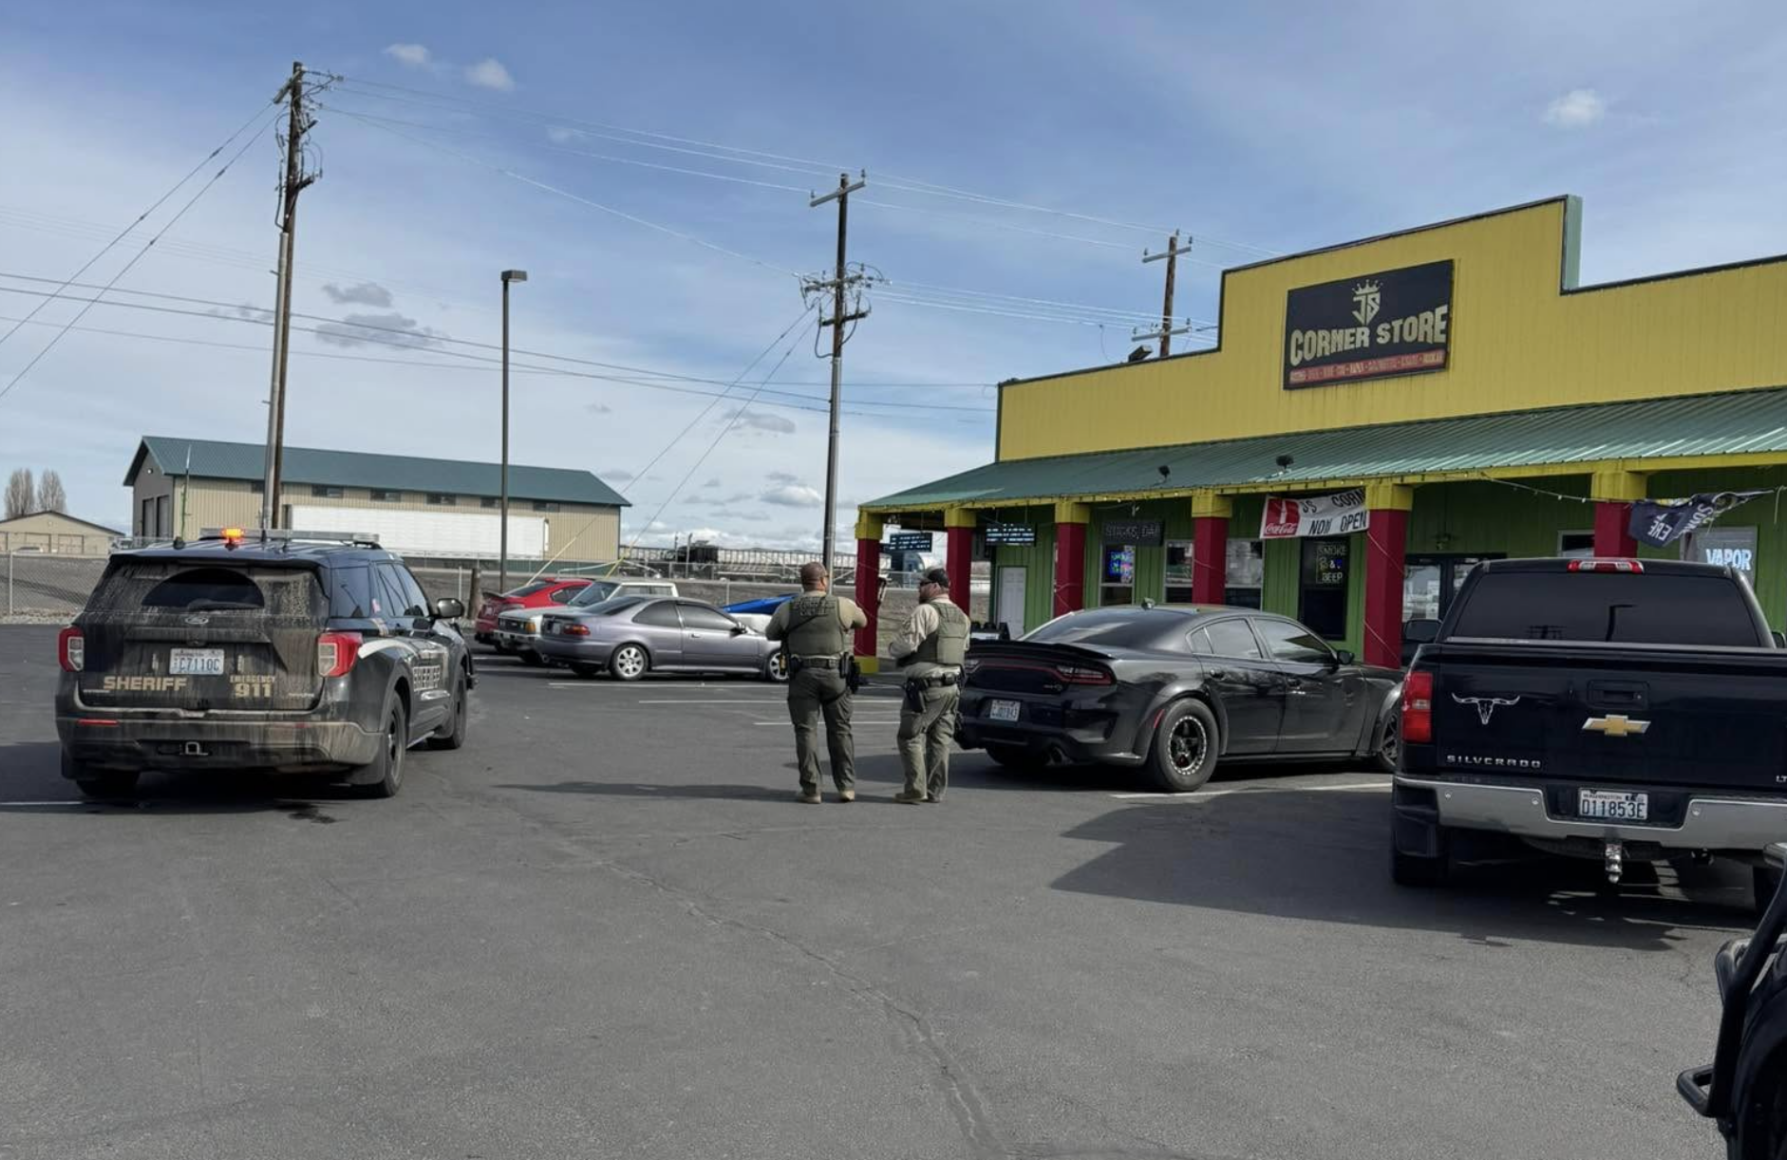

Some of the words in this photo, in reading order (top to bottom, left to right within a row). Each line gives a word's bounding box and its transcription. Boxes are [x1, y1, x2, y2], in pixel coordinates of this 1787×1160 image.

[1290, 326, 1370, 367] CORNER
[1376, 304, 1449, 344] STORE
[1308, 518, 1333, 536] NOW
[1340, 511, 1367, 532] OPEN
[1705, 548, 1752, 571] VAPOR
[103, 675, 188, 692] SHERIFF
[235, 683, 272, 698] 911
[1447, 755, 1541, 768] SILVERADO
